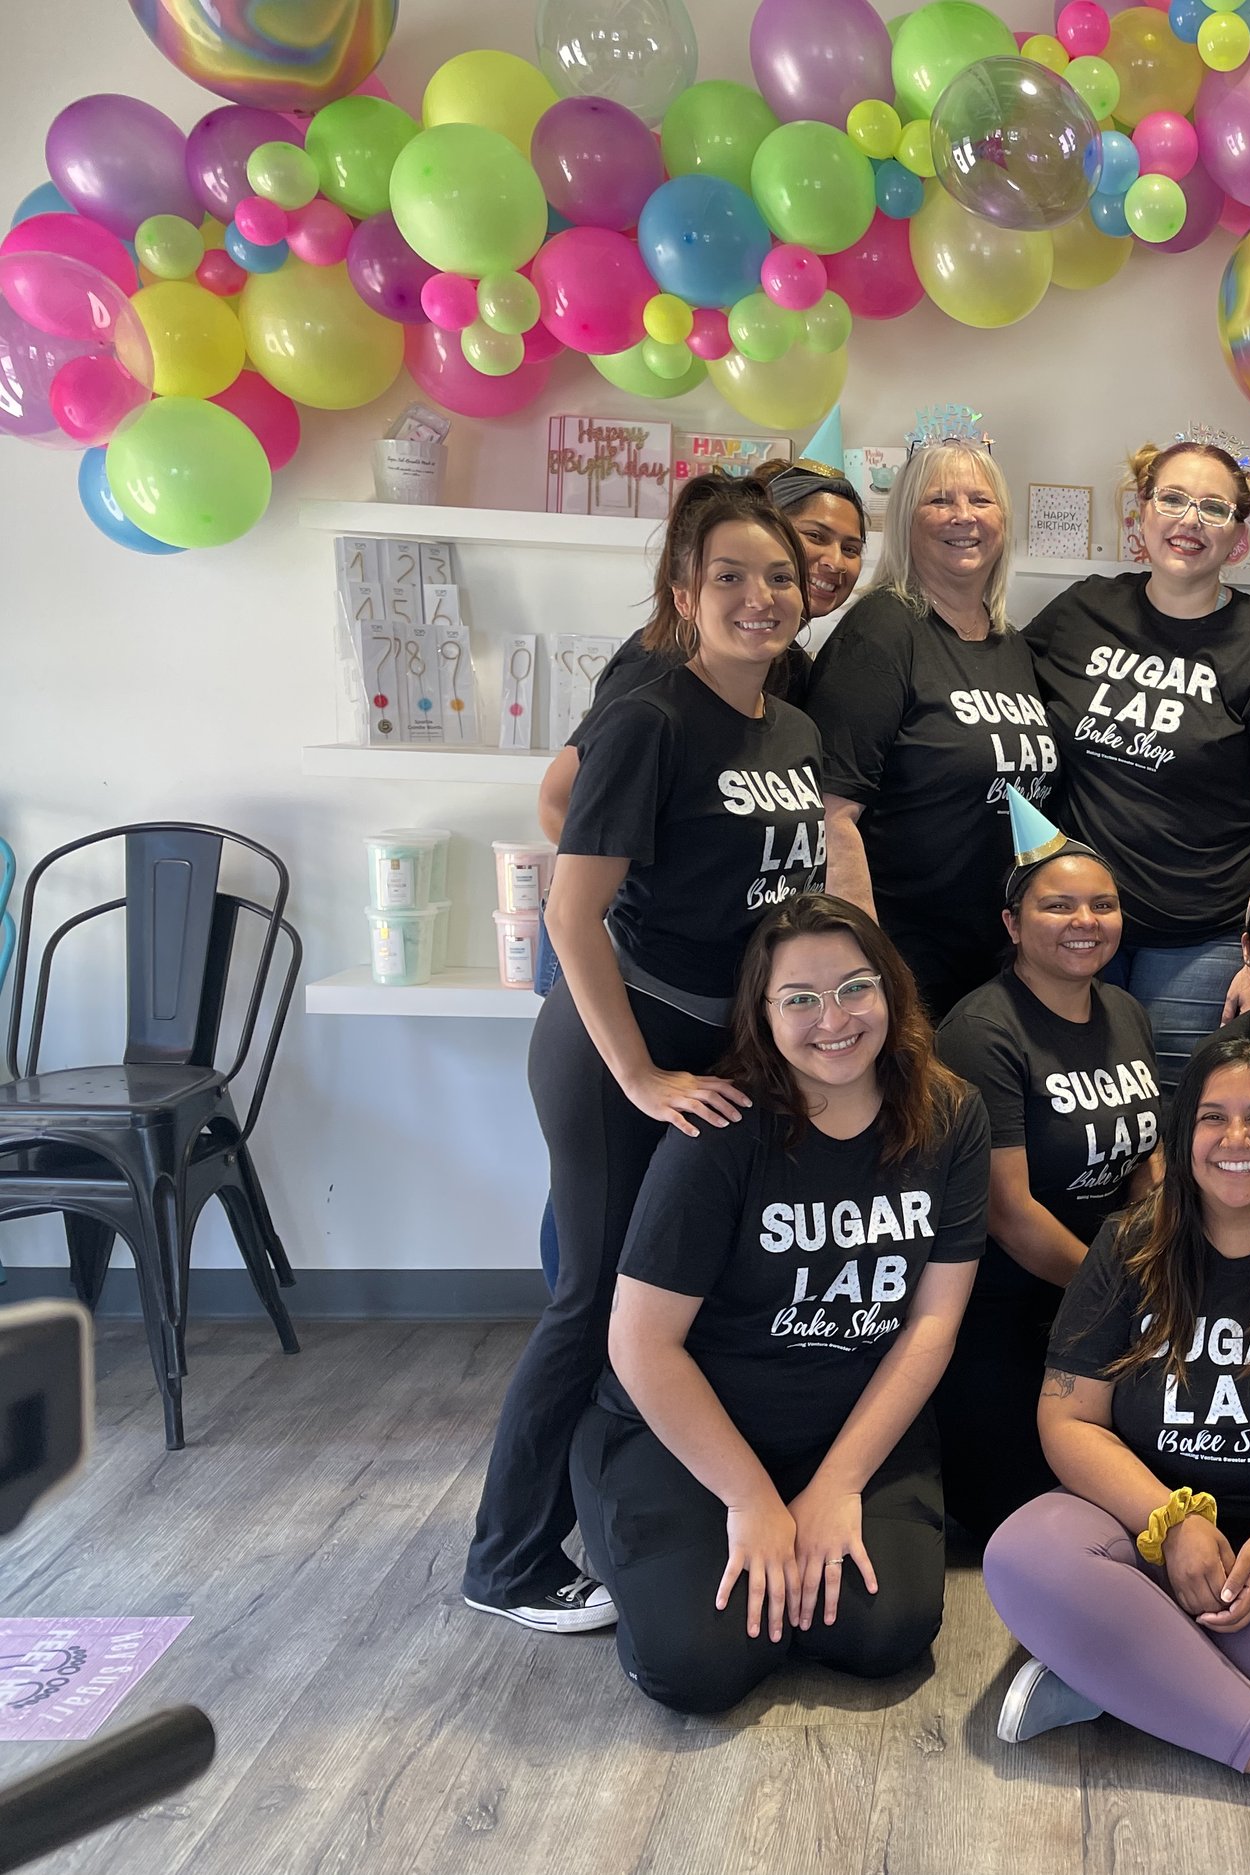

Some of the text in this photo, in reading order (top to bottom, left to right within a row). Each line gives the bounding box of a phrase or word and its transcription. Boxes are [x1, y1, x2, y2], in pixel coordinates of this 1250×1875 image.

[578, 419, 649, 450] Happy
[692, 437, 773, 460] HAPPY
[1036, 520, 1082, 531] BIRTHDAY
[1043, 511, 1077, 521] HAPPY
[1085, 646, 1217, 704] SUGAR
[950, 688, 1049, 728] SUGAR
[1088, 682, 1185, 733] LAB
[990, 733, 1058, 772] LAB
[1074, 715, 1124, 749] Bake
[1126, 730, 1176, 769] Shop
[1025, 772, 1052, 808] Shop
[760, 820, 827, 873] LAB
[1045, 1060, 1160, 1114] SUGAR
[1085, 1111, 1157, 1166] LAB
[1066, 1163, 1113, 1191] Bake
[759, 1190, 935, 1254] SUGAR
[790, 1255, 908, 1306] LAB
[770, 1302, 901, 1343] Bake Shop
[1157, 1429, 1226, 1453] Bake
[12, 1629, 79, 1674] FEET
[104, 1630, 144, 1661] Hey
